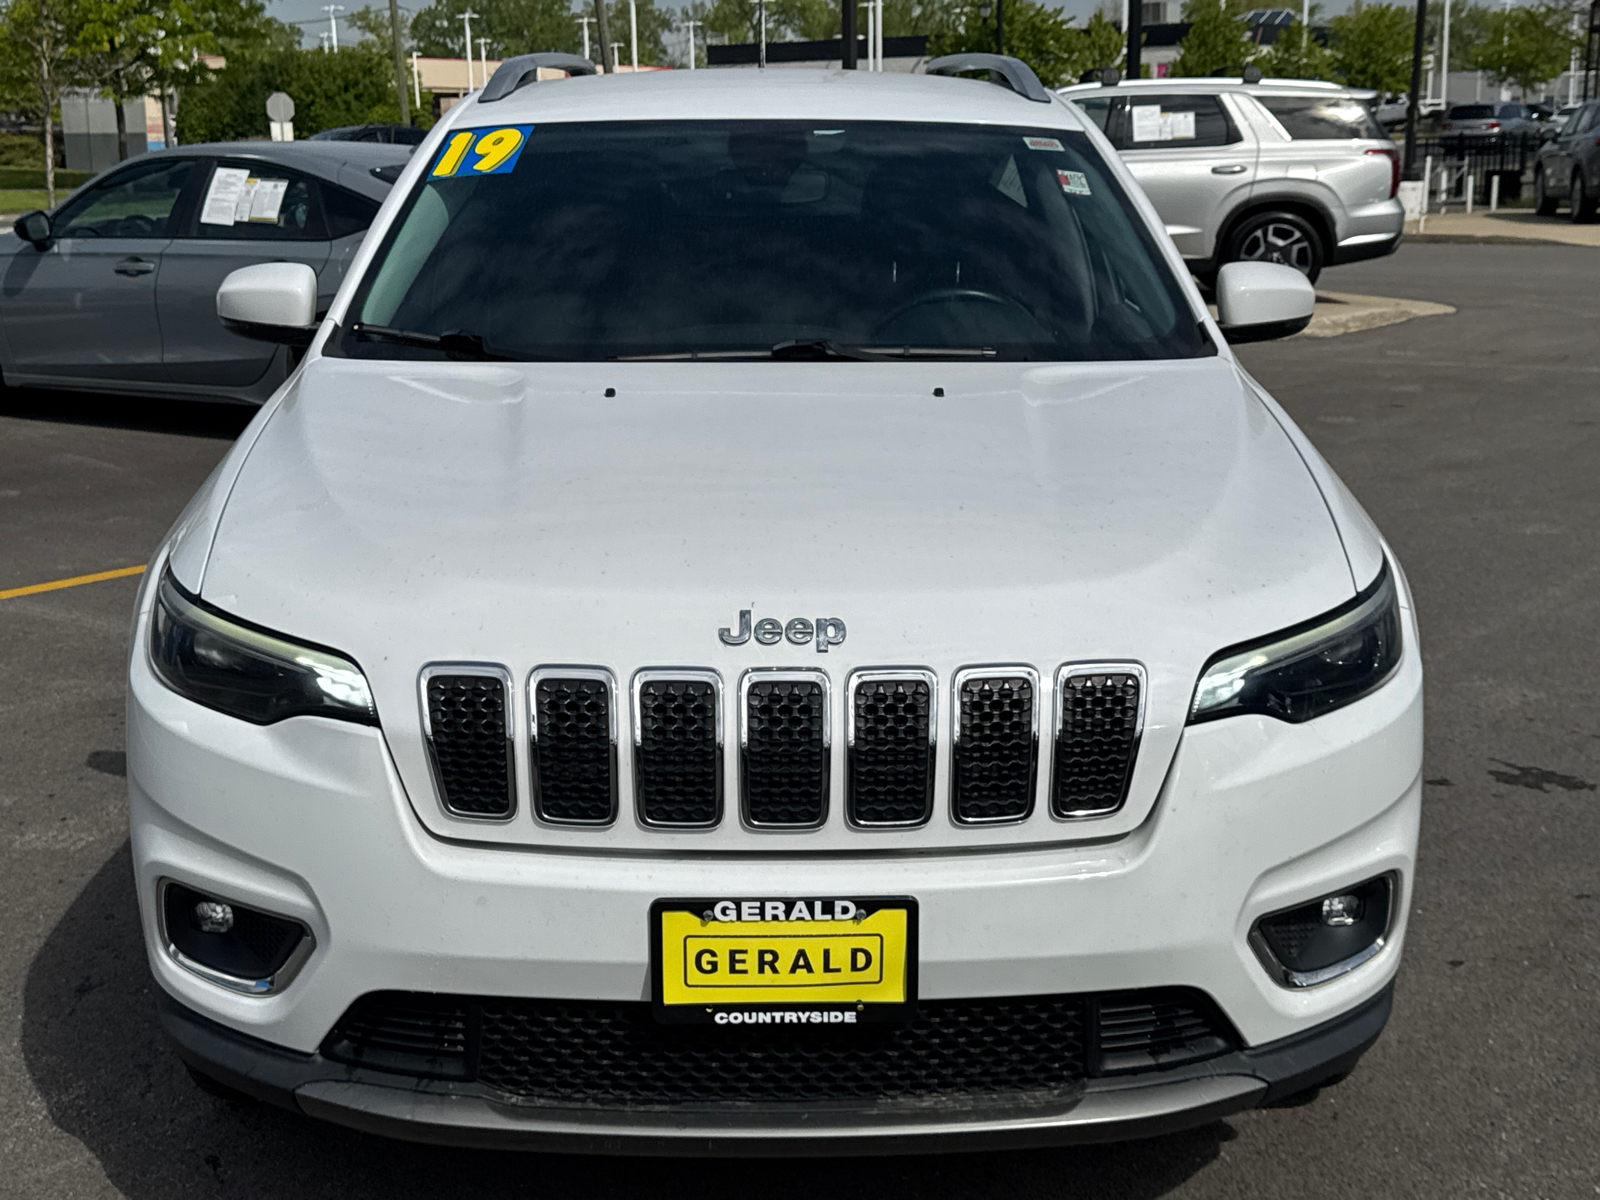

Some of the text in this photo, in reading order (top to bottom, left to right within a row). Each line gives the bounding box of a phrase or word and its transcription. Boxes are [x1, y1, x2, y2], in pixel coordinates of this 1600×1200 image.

[432, 128, 524, 176] 19
[718, 609, 847, 653] Jeep
[713, 900, 857, 922] GERALD
[694, 948, 873, 975] GERALD
[714, 1011, 857, 1024] COUNTRYSIDE
